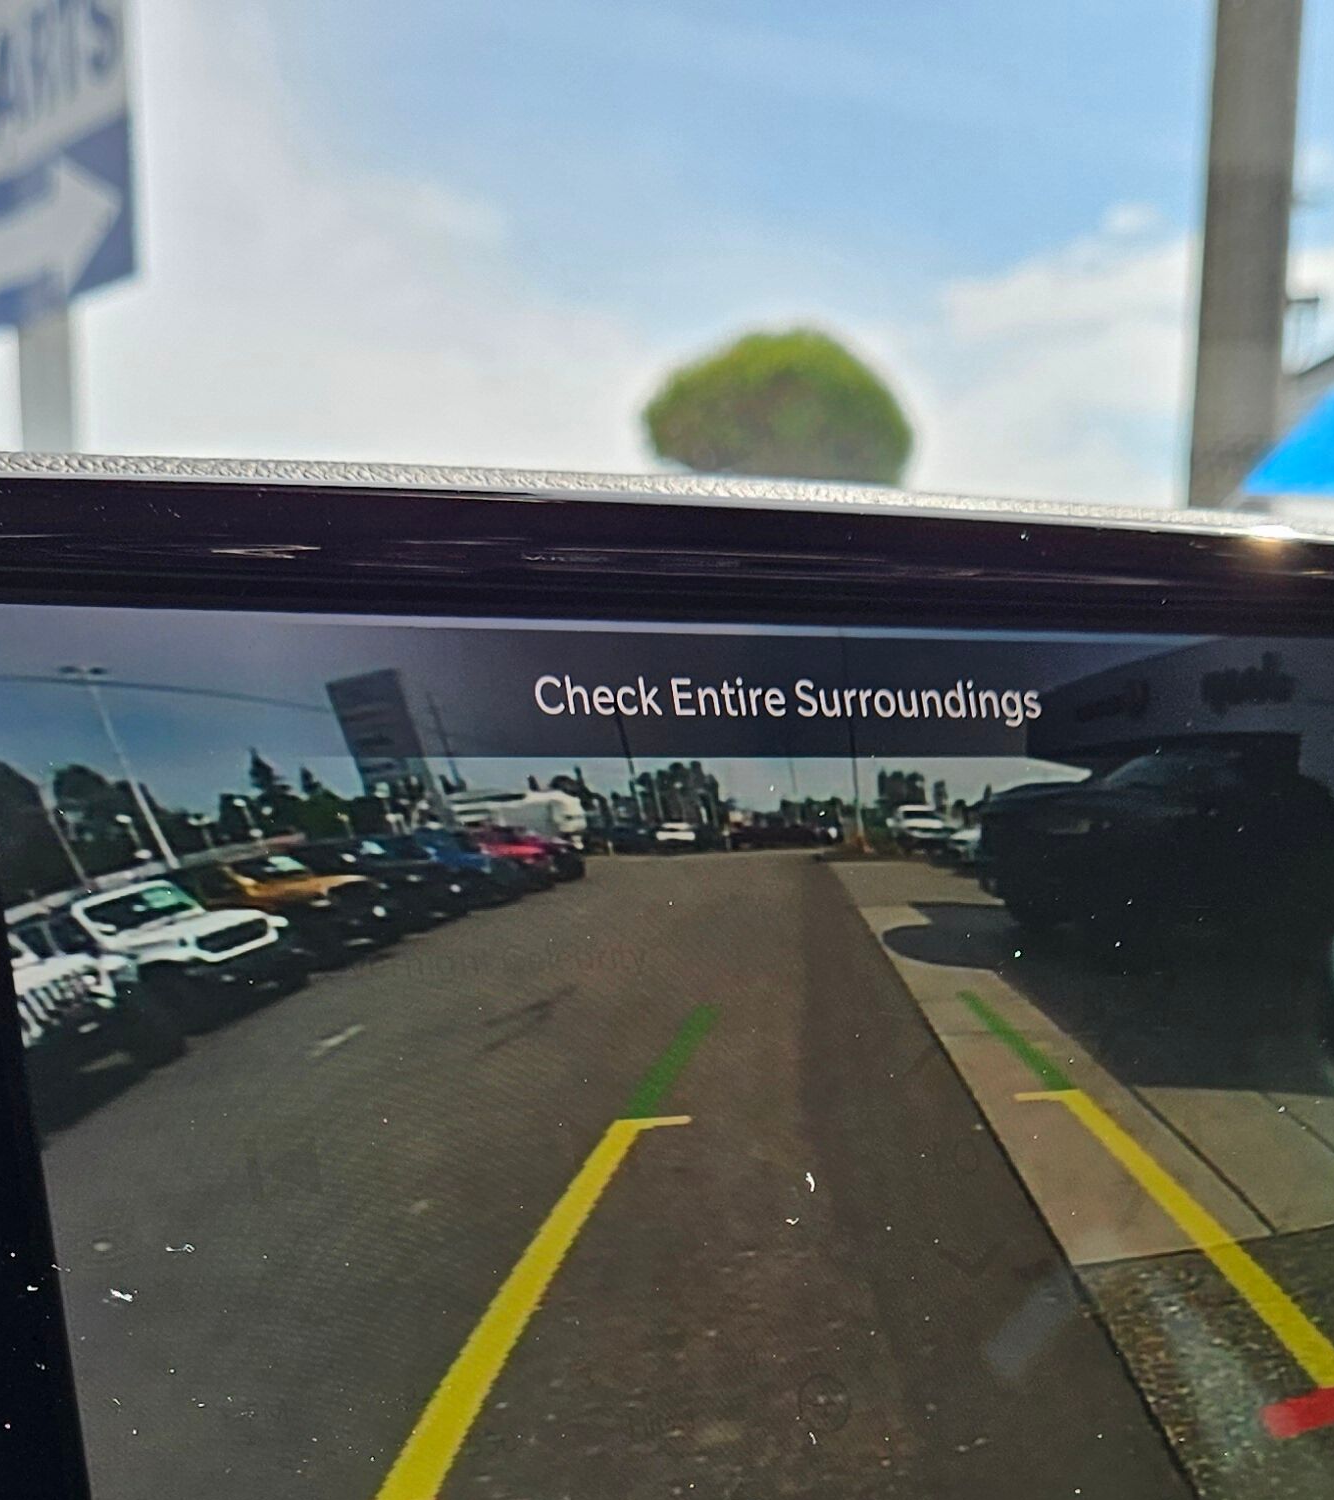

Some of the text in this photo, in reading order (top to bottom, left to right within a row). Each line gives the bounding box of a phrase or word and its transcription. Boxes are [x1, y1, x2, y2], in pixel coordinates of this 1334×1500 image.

[534, 674, 663, 717] Check
[670, 676, 787, 718] Entire
[796, 678, 1043, 728] Surroundings
